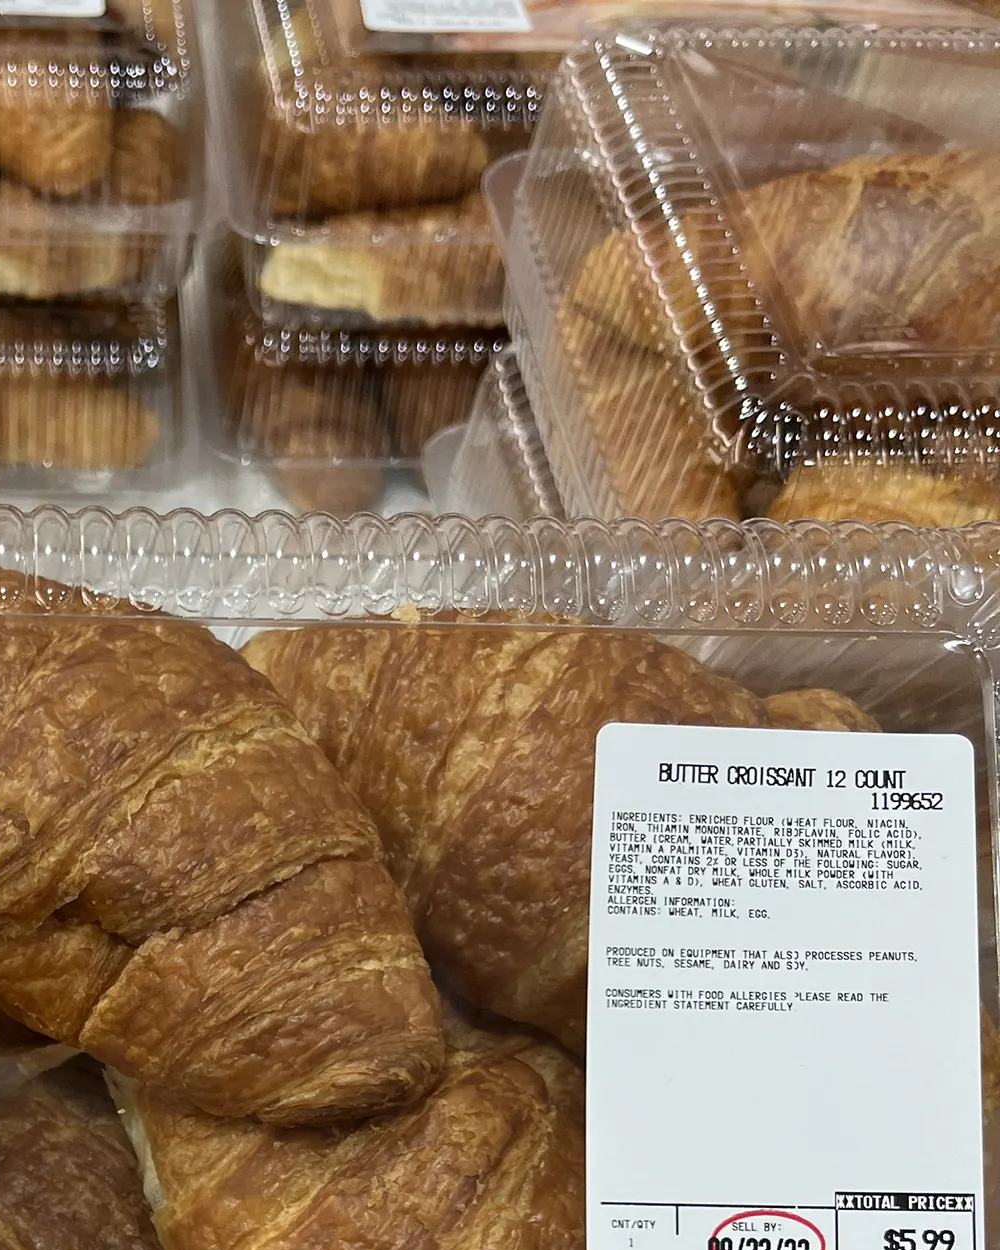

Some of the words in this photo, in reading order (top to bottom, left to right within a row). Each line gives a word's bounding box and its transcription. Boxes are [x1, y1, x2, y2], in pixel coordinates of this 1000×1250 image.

[659, 763, 719, 784] BUTTER
[727, 765, 816, 787] CROISSANT
[827, 768, 846, 788] 12
[855, 769, 906, 789] COUNT
[872, 793, 943, 810] 1199652
[612, 812, 682, 823] INGREDIENTS:
[690, 814, 738, 824] ENRICHED
[744, 815, 774, 825] FLOUR
[647, 824, 689, 834] THIAMIN
[849, 829, 880, 838] FOLIC
[610, 834, 646, 842] BUTTER
[799, 838, 842, 847] SKIMMED
[849, 839, 874, 848] MILK
[610, 844, 652, 853] VITAMIN
[737, 847, 780, 856] VITAMIN
[817, 849, 858, 858] NATURAL
[652, 855, 700, 865] CONTAINS
[725, 857, 737, 866] OR
[743, 857, 768, 866] LESS
[774, 858, 786, 866] OF
[794, 858, 810, 867] THE
[817, 859, 878, 868] FOLLOWING:
[645, 866, 682, 875] NONFAT
[688, 866, 706, 875] DRY
[749, 868, 779, 877] WHOLE
[786, 868, 811, 877] MILK
[817, 869, 855, 878] POWDER
[863, 870, 893, 879] (WITH
[609, 875, 657, 885] VITAMINS
[712, 877, 742, 886] WHEAT
[836, 879, 887, 889] ASCORBIC
[608, 896, 656, 906] ALLERGEN
[664, 898, 734, 907] INFORMATION:
[608, 906, 660, 916] CONTAINS:
[606, 947, 656, 957] PRODUCED
[662, 948, 674, 957] ON
[680, 948, 736, 958] EQUIPMENT
[743, 949, 767, 959] THAT
[805, 950, 862, 960] PROCESSES
[607, 958, 631, 967] TREE
[724, 960, 754, 970] DAIRY
[761, 961, 780, 970] AND
[606, 989, 662, 999] CONSUMERS
[668, 990, 692, 999] WITH
[699, 990, 724, 1000] FOOD
[730, 991, 786, 1001] ALLERGIES
[838, 993, 863, 1002] READ
[870, 993, 888, 1002] THE
[607, 1000, 667, 1010] INGREDIENT
[674, 1001, 730, 1011] STATEMENT
[612, 1220, 656, 1230] CNT/QTY
[732, 1222, 758, 1232] SELL
[764, 1223, 781, 1232] BY:
